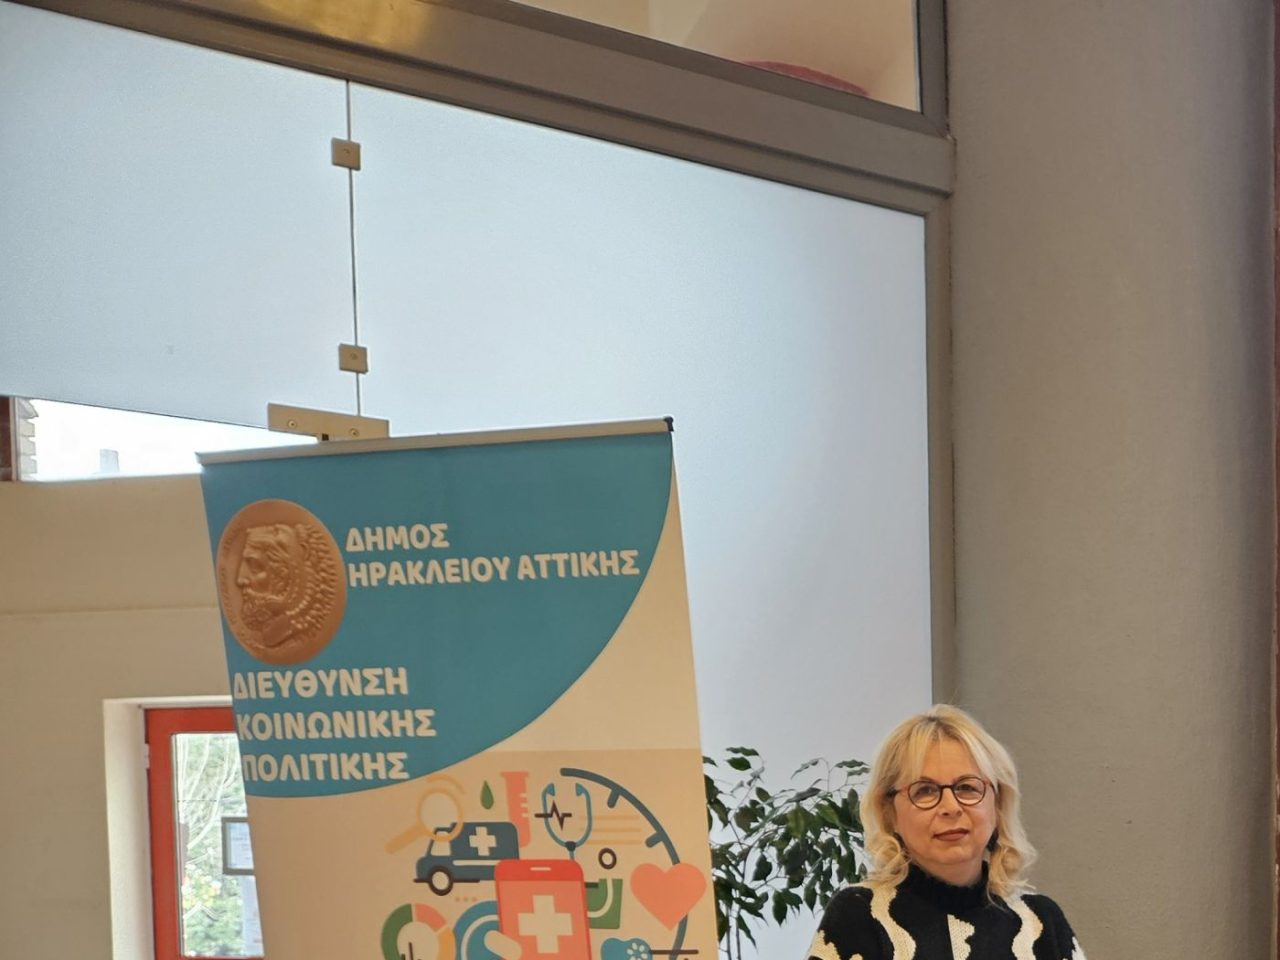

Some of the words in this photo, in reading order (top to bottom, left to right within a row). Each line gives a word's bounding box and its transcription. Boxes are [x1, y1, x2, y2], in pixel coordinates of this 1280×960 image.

[346, 523, 449, 552] ΔΗΜΟΣ
[348, 556, 510, 588] ΗΡΑΚΛΕΙΟΥ
[517, 550, 640, 580] ΑΤΤΙΚΗΣ
[233, 667, 409, 700] ΔΙΕΥΘΥΝΣΗ
[237, 709, 437, 741] ΚΟΙΝΩΝΙΚΗΣ
[243, 752, 410, 783] ΠΟΛΙΤΙΚΗΣ
